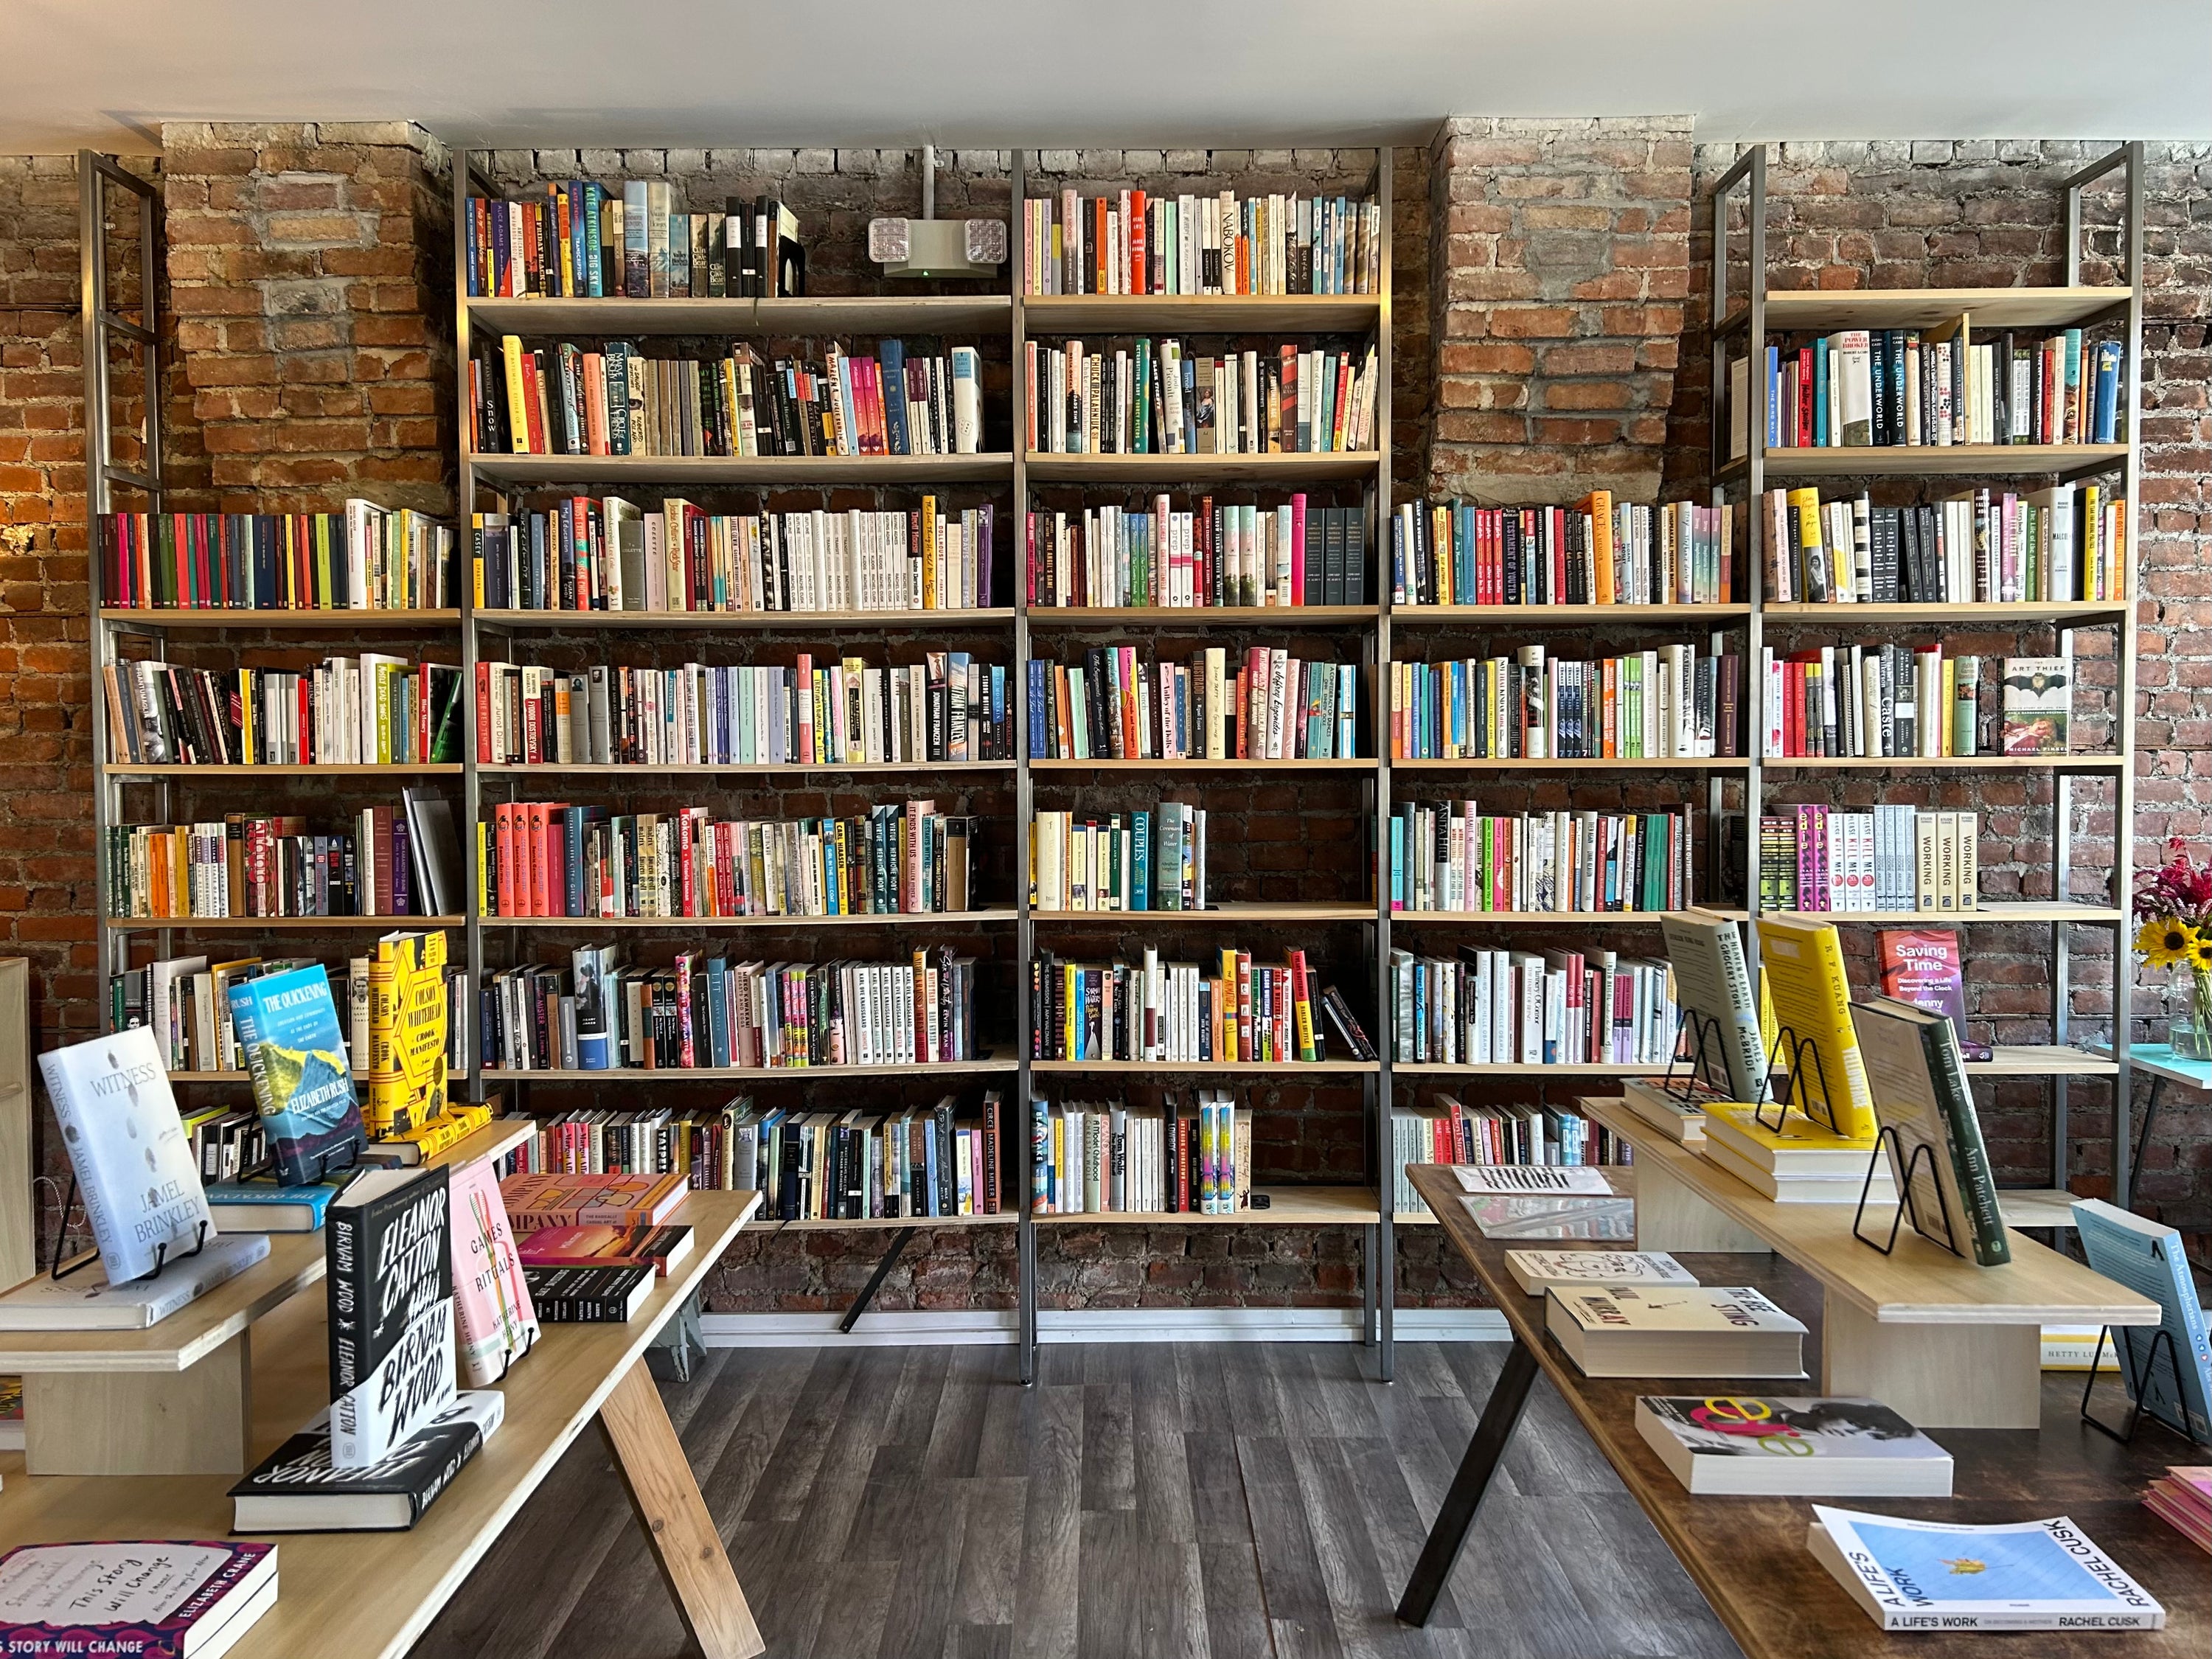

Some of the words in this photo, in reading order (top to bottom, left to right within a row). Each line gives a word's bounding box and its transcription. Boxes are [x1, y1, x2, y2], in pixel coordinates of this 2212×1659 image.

[586, 186, 595, 206] KATE
[587, 209, 597, 251] ATKINSON
[1222, 211, 1234, 271] NABOKOV
[588, 254, 598, 268] BIG
[590, 270, 598, 285] SKY
[829, 355, 838, 392] MARLENA
[1091, 356, 1100, 382] CHUCK
[1091, 389, 1100, 430] PALAHNIUK
[562, 507, 569, 518] My
[1595, 496, 1606, 529] GRACE
[912, 531, 920, 553] House
[1171, 529, 1179, 550] prep
[1183, 528, 1191, 549] prep
[1507, 520, 1515, 554] TESTAMENT
[1509, 555, 1515, 564] OF
[1509, 566, 1517, 594] YOUTH
[136, 668, 148, 717] FRANTUMAGLIA
[495, 706, 503, 728] Junot
[527, 700, 535, 720] FYODOR
[1882, 696, 1893, 737] Caste
[529, 721, 537, 753] DOSTOEVSKY
[682, 813, 690, 849] Kokomo
[1438, 802, 1447, 834] ANITA
[910, 846, 917, 858] US
[1134, 816, 1145, 860] COUPLES
[1439, 838, 1448, 859] HILL
[1923, 836, 1932, 885] WORKING
[1943, 837, 1951, 886] WORKING
[1964, 835, 1972, 884] WORKING
[1717, 931, 1736, 942] THE
[1896, 945, 1947, 959] Saving
[1719, 944, 1736, 981] GROCERY
[1730, 981, 1742, 1010] STORE
[1730, 942, 1741, 970] HEAVEN
[1739, 978, 1752, 1009] EARTH
[1897, 977, 1934, 985] Discovering
[1903, 959, 1944, 971] Time
[263, 995, 282, 1014] THE
[282, 981, 327, 1009] QUICKENING
[415, 984, 436, 1006] COLSON
[712, 973, 720, 992] LIT
[1830, 975, 1846, 1016] KUANG
[231, 996, 252, 1009] RUSH
[372, 987, 380, 1024] WHITEHEAD
[380, 994, 389, 1018] COLSON
[408, 1002, 441, 1029] WHITEHEAD
[240, 1017, 254, 1043] THE
[416, 1028, 435, 1042] CROOK
[1748, 1030, 1762, 1062] JAMES
[372, 1034, 380, 1069] MANIFESTO
[380, 1041, 389, 1062] CROOK
[409, 1038, 440, 1057] MANIFESTO
[1737, 1026, 1756, 1073] McBRIDE
[89, 1062, 156, 1098] WITNESS
[246, 1043, 276, 1116] QUICKENING
[1842, 1044, 1868, 1110] YELLOWFACE
[1938, 1037, 1952, 1073] Tom
[1947, 1071, 1961, 1104] Lake
[291, 1084, 331, 1114] ELIZABETH
[330, 1077, 349, 1098] RUSH
[46, 1063, 72, 1119] WITNESS
[74, 1141, 91, 1186] JAMEL
[83, 1182, 112, 1245] BRINKLEY
[658, 1131, 667, 1169] TAIPEI
[141, 1180, 185, 1214] JAMEL
[1964, 1145, 1980, 1175] Ann
[1972, 1173, 1994, 1228] Patchett
[134, 1196, 201, 1244] BRINKLEY
[378, 1186, 446, 1279] ELEANOR
[335, 1221, 354, 1273] BIRNAM
[470, 1222, 503, 1254] GAMES
[383, 1228, 442, 1318] CATTON
[476, 1252, 515, 1293] RITUALS
[2170, 1243, 2180, 1262] The
[2175, 1261, 2197, 1331] Atmospherians
[335, 1278, 354, 1313] WOOD
[1723, 1288, 1760, 1300] THE
[1739, 1300, 1778, 1313] BEE
[452, 1285, 469, 1329] KATHERINE
[465, 1328, 476, 1356] HEINY
[493, 1300, 521, 1330] KATHERINE
[1711, 1304, 1760, 1326] STING
[337, 1337, 356, 1386] ELEANOR
[378, 1304, 447, 1412] BIRNAM
[338, 1391, 356, 1437] CATTON
[387, 1347, 444, 1450] WOOD
[2042, 1519, 2090, 1556] CUSK
[69, 1585, 102, 1610] This
[97, 1557, 143, 1586] Story
[132, 1555, 170, 1589] Change
[178, 1579, 227, 1619] ELIZABETH
[223, 1551, 256, 1579] CRANE
[1849, 1551, 1891, 1598] LIFE'S
[1885, 1568, 1935, 1607] WORK
[2083, 1556, 2152, 1608] RACHEL
[1883, 1596, 1906, 1607] A
[1891, 1617, 1902, 1627] A
[1902, 1616, 1939, 1627] LIFE'S
[1941, 1616, 1978, 1627] WORK
[2058, 1616, 2106, 1627] RACHEL
[2108, 1616, 2141, 1627] CUSK
[8, 1641, 50, 1654] STORY
[55, 1641, 83, 1653] WILL
[88, 1640, 143, 1654] CHANGE
